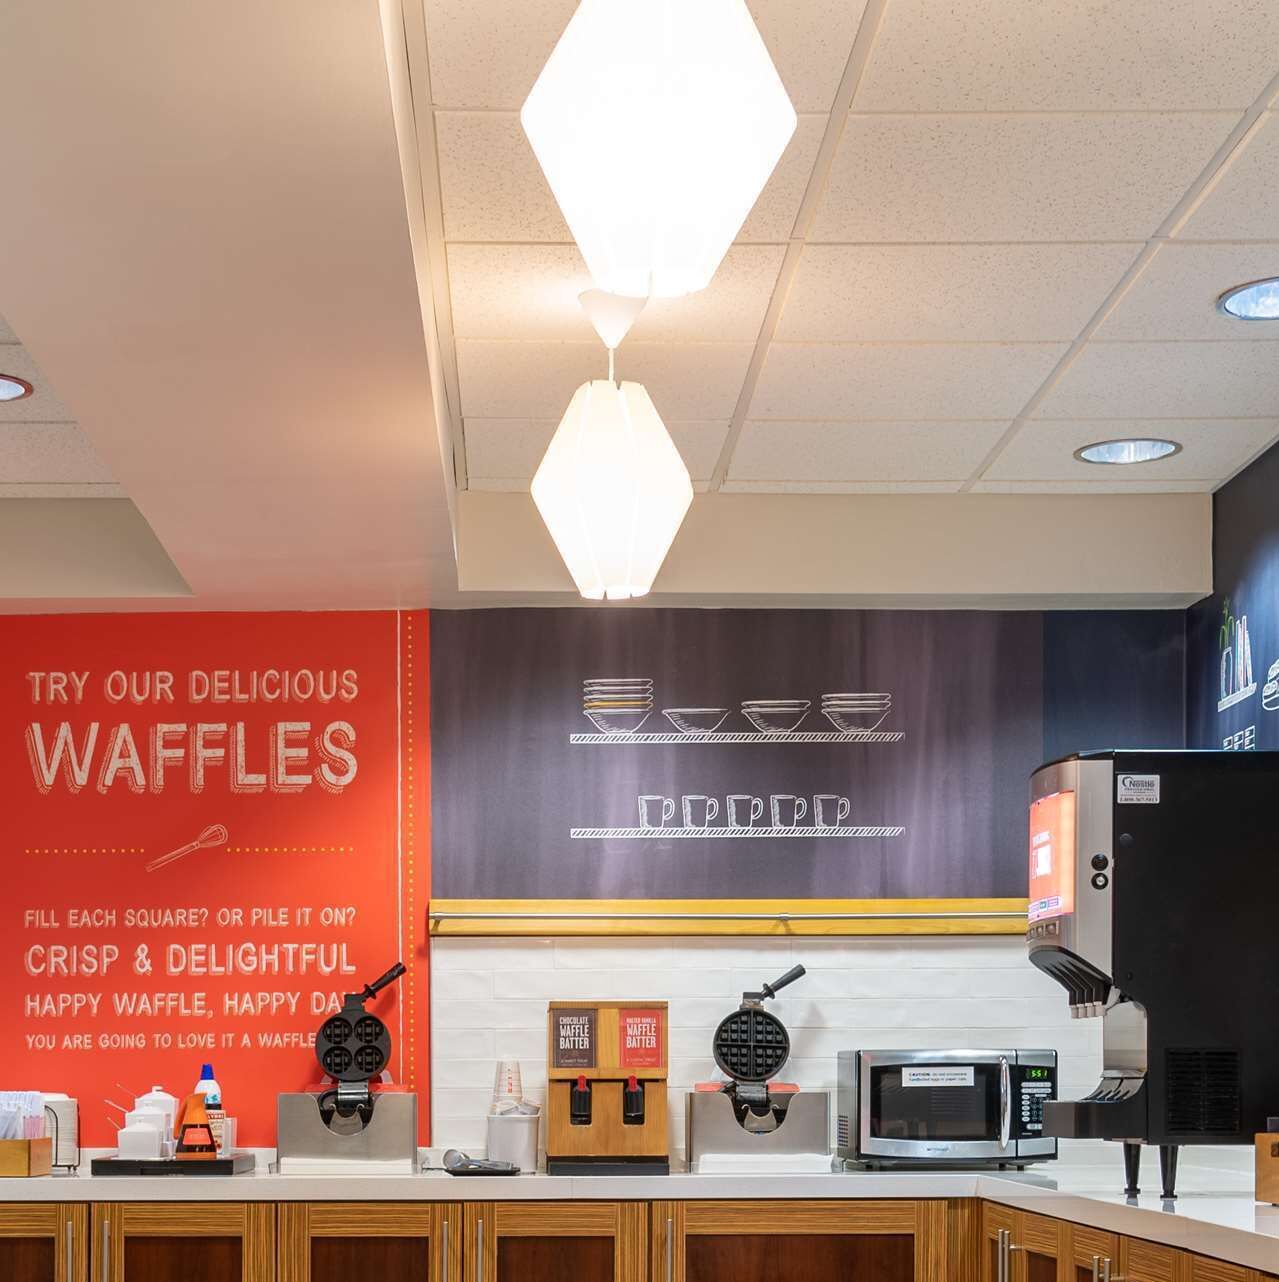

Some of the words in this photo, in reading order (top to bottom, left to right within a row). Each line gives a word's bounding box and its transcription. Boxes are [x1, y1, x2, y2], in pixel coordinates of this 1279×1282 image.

[26, 670, 90, 704] TRY
[105, 670, 175, 704] OUR
[188, 669, 359, 703] DELICIOUS
[24, 719, 359, 796] WAFFLES
[24, 909, 60, 928] FILL
[69, 909, 116, 928] EACH
[125, 908, 209, 928] SQUARE?
[216, 908, 243, 927] OR
[251, 907, 289, 927] PILE
[296, 907, 312, 926] IT
[320, 907, 357, 927] ON?
[25, 944, 120, 977] CRISP
[134, 943, 153, 977] &
[167, 942, 357, 976] DELIGHTFUL
[24, 993, 103, 1017] HAPPY
[113, 992, 214, 1018] WAFFLE,
[223, 992, 300, 1016] HAPPY
[310, 992, 354, 1015] DA
[559, 1016, 589, 1025] CHOCOLATE
[559, 1025, 590, 1037] WAFFLE
[626, 1024, 657, 1036] WAFFLE
[26, 1033, 56, 1050] YOU
[62, 1033, 93, 1049] ARE
[99, 1033, 146, 1049] GOING
[153, 1033, 172, 1049] TO
[178, 1033, 216, 1049] LOVE
[222, 1033, 235, 1049] IT
[240, 1033, 252, 1048] A
[258, 1032, 316, 1049] WAFFLE
[559, 1037, 590, 1049] BATTER
[626, 1036, 657, 1048] BATTER
